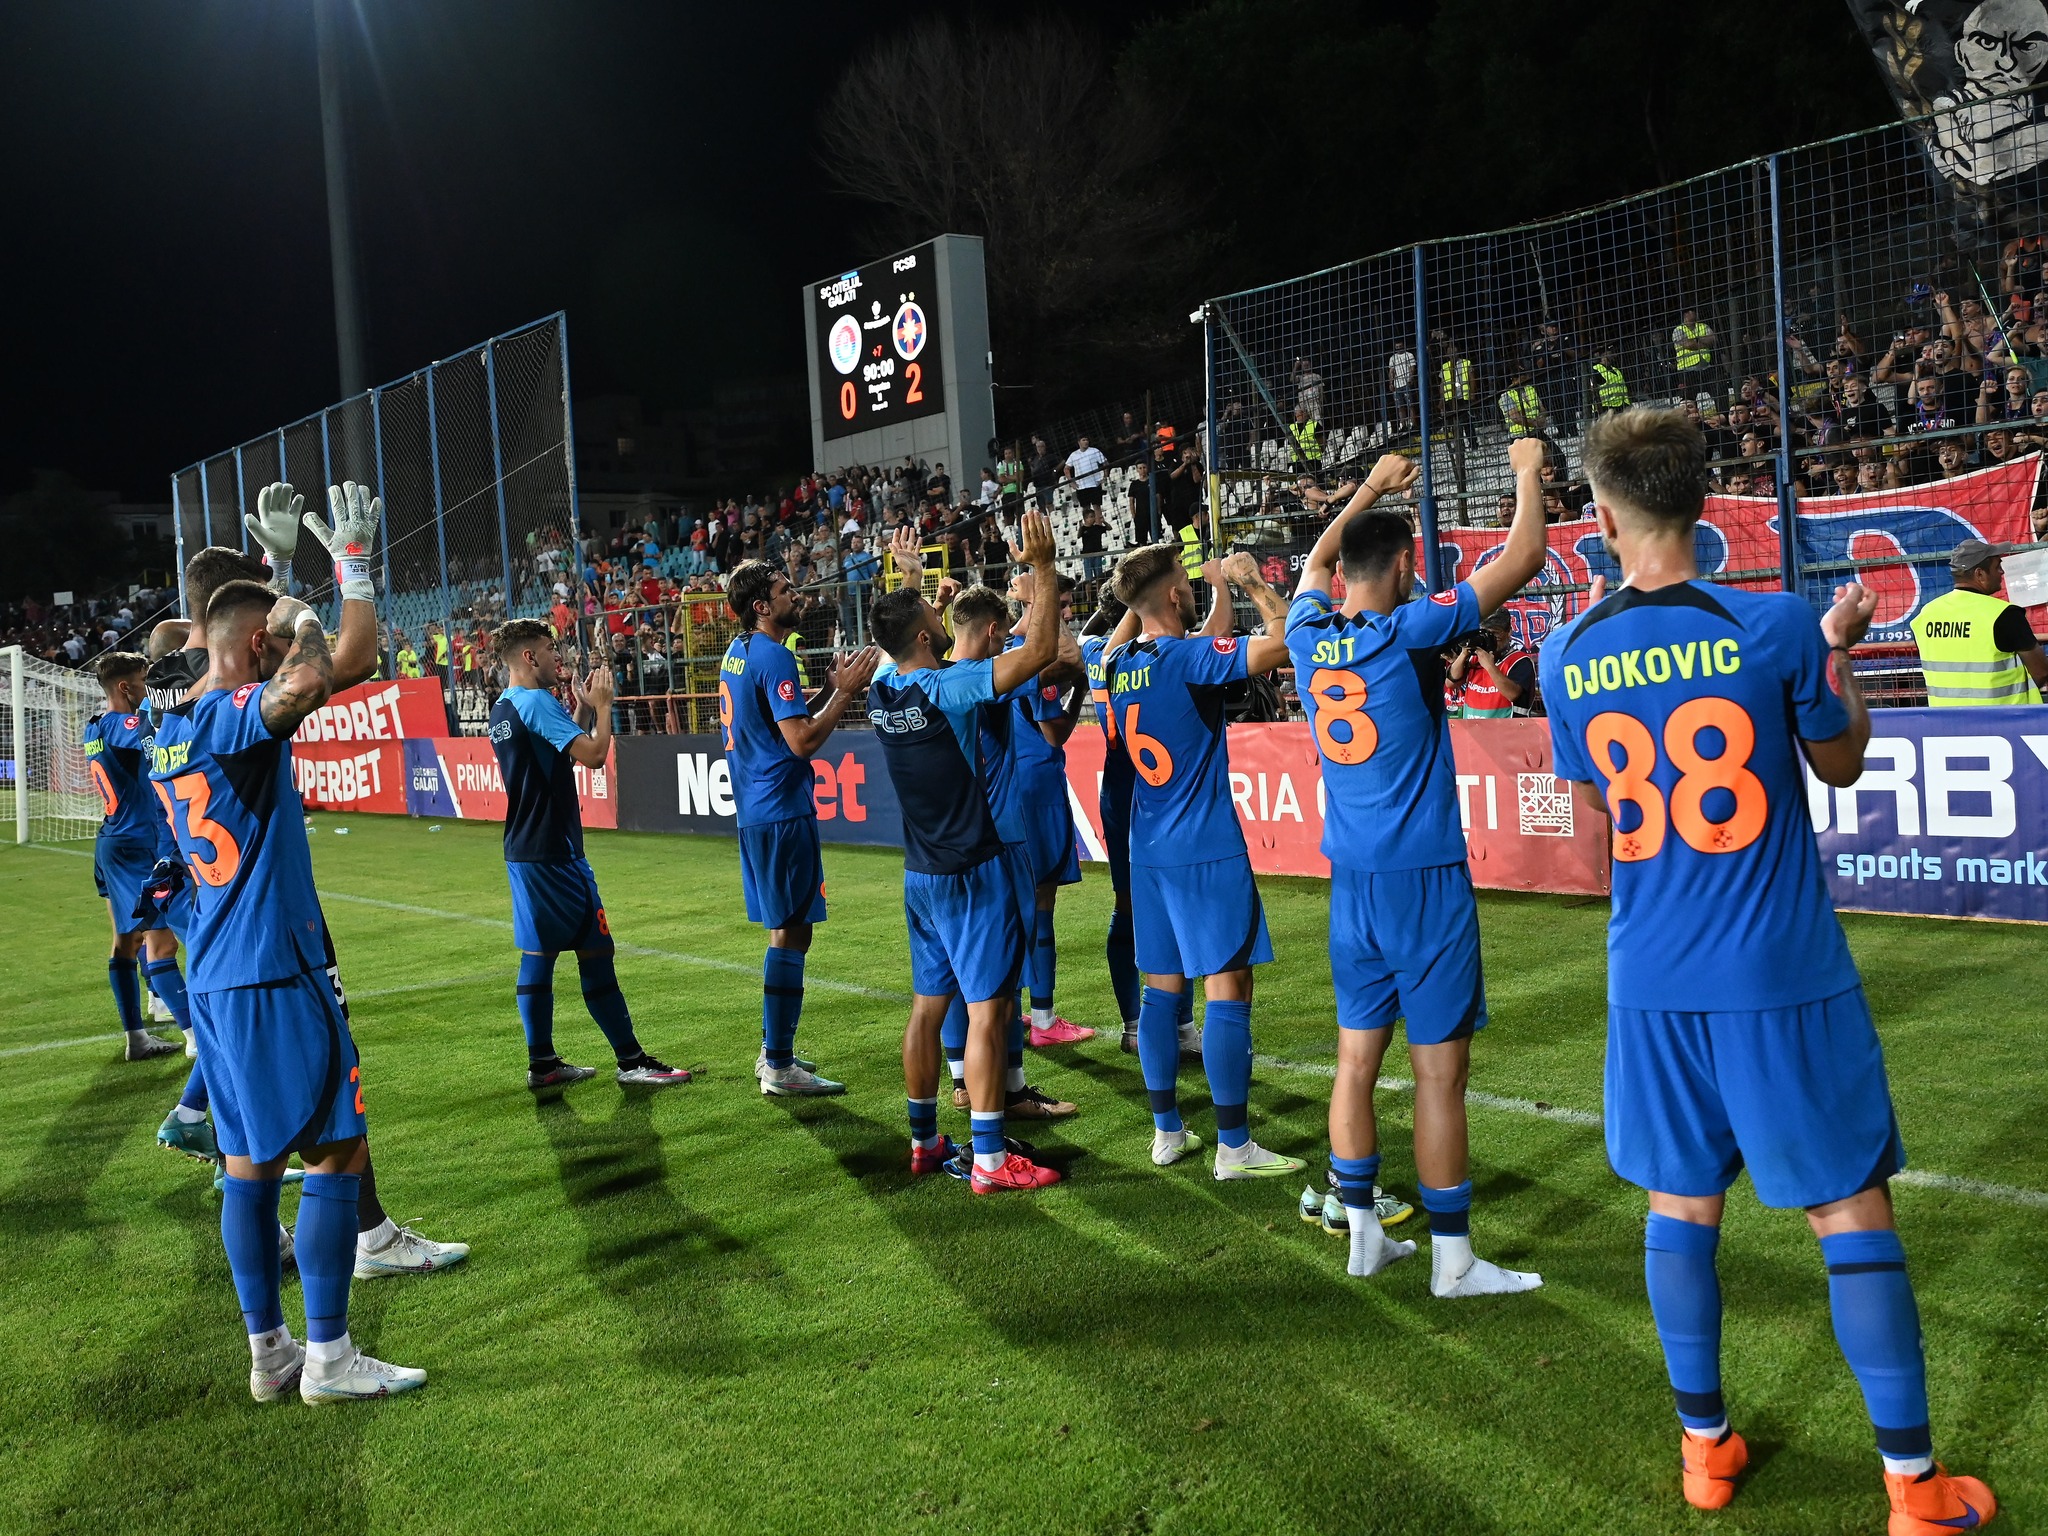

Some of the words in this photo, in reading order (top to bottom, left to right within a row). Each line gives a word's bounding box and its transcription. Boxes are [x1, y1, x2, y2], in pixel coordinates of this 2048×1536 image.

[893, 255, 916, 274] FCSB
[820, 286, 832, 299] SC
[832, 275, 862, 296] OTELUL
[828, 290, 857, 308] GALATI
[863, 358, 895, 382] 90:00
[872, 345, 883, 357] +7
[840, 381, 857, 420] 0
[905, 362, 923, 404] 2
[1879, 631, 1911, 641] 1995
[1926, 622, 1971, 638] ORDINE
[1563, 638, 1740, 700] DJOKOVIC
[290, 684, 405, 743] UPERBET
[1307, 667, 1379, 765] 8
[1125, 702, 1174, 787] 6
[291, 748, 381, 803] UPERBET
[1585, 695, 1768, 863] 88
[1837, 848, 1942, 886] sports
